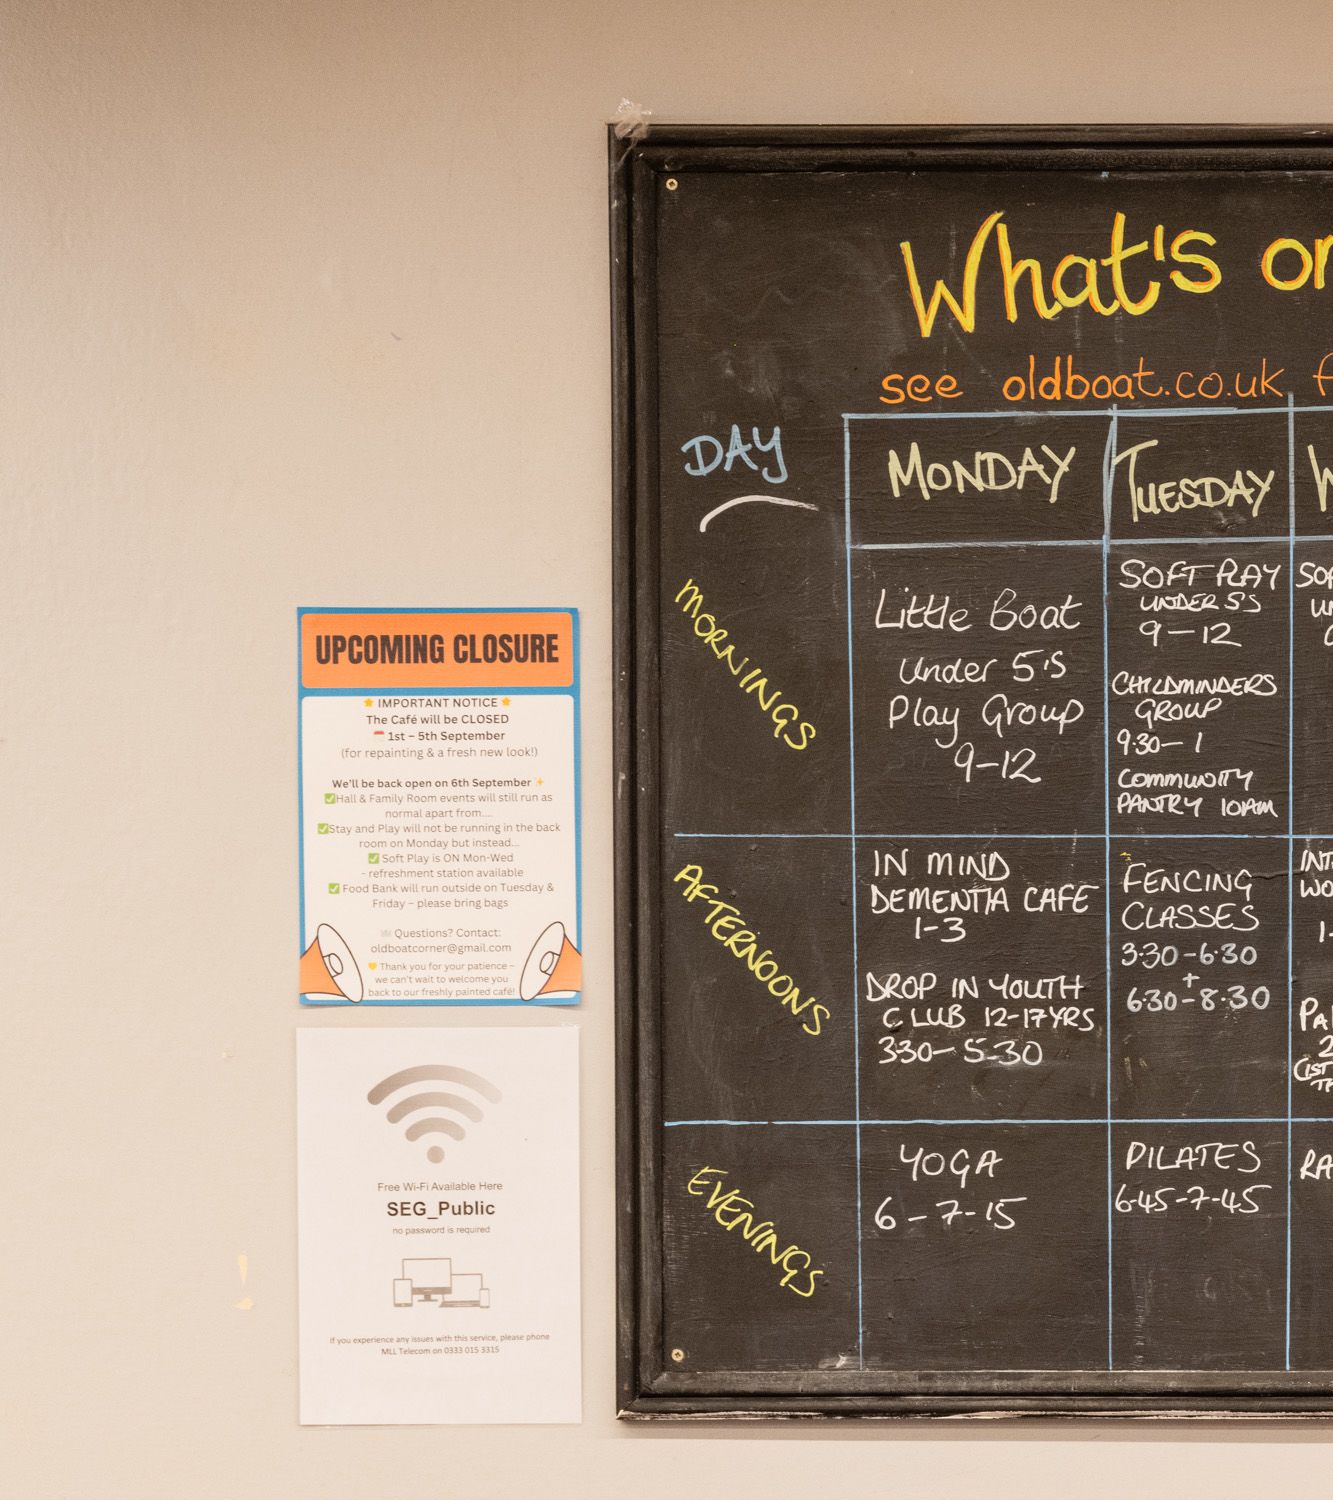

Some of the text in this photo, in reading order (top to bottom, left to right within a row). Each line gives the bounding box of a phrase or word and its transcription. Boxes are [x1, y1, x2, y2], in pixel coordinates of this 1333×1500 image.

[901, 211, 1222, 337] What's
[880, 372, 964, 405] see
[1003, 356, 1285, 402] oldboat.co.uk
[678, 425, 789, 485] DAY
[874, 586, 1084, 632] Little Boat
[315, 632, 560, 665] UPCOMING CLOSURE
[674, 578, 816, 751] MORNINGS
[898, 655, 998, 685] Under
[1111, 670, 1278, 697] CHILDMINDERS
[366, 712, 510, 726] The Café will be CLOSED
[377, 696, 499, 709] IMPORTANT NOTICE
[1134, 697, 1223, 730] GROUP
[387, 730, 406, 742] 1st
[417, 730, 438, 742] 5th
[440, 729, 506, 744] September
[889, 693, 1085, 748] Play Group
[360, 778, 375, 789] be
[377, 777, 403, 789] back
[404, 779, 433, 791] open
[434, 780, 449, 788] on
[450, 778, 470, 788] 6th
[471, 776, 532, 790] September
[381, 852, 514, 866] Soft Play is ON Mon-Wed
[873, 848, 1012, 882] IN MIND
[1122, 862, 1254, 902] FENCING
[870, 883, 1101, 915] DEMENTIA CAFE
[1120, 900, 1261, 932] CLASSES
[370, 941, 512, 956] oldboatcorner@gmail.com
[673, 863, 832, 1038] AFTERNOONS
[899, 1142, 1004, 1191] YOGA
[1125, 1139, 1263, 1174] PILATES
[377, 1181, 504, 1192] Free Wi-Fi Available Here
[386, 1200, 496, 1220] SEG_Public
[392, 1225, 491, 1237] no password is required
[686, 1165, 825, 1298] EVENINGS
